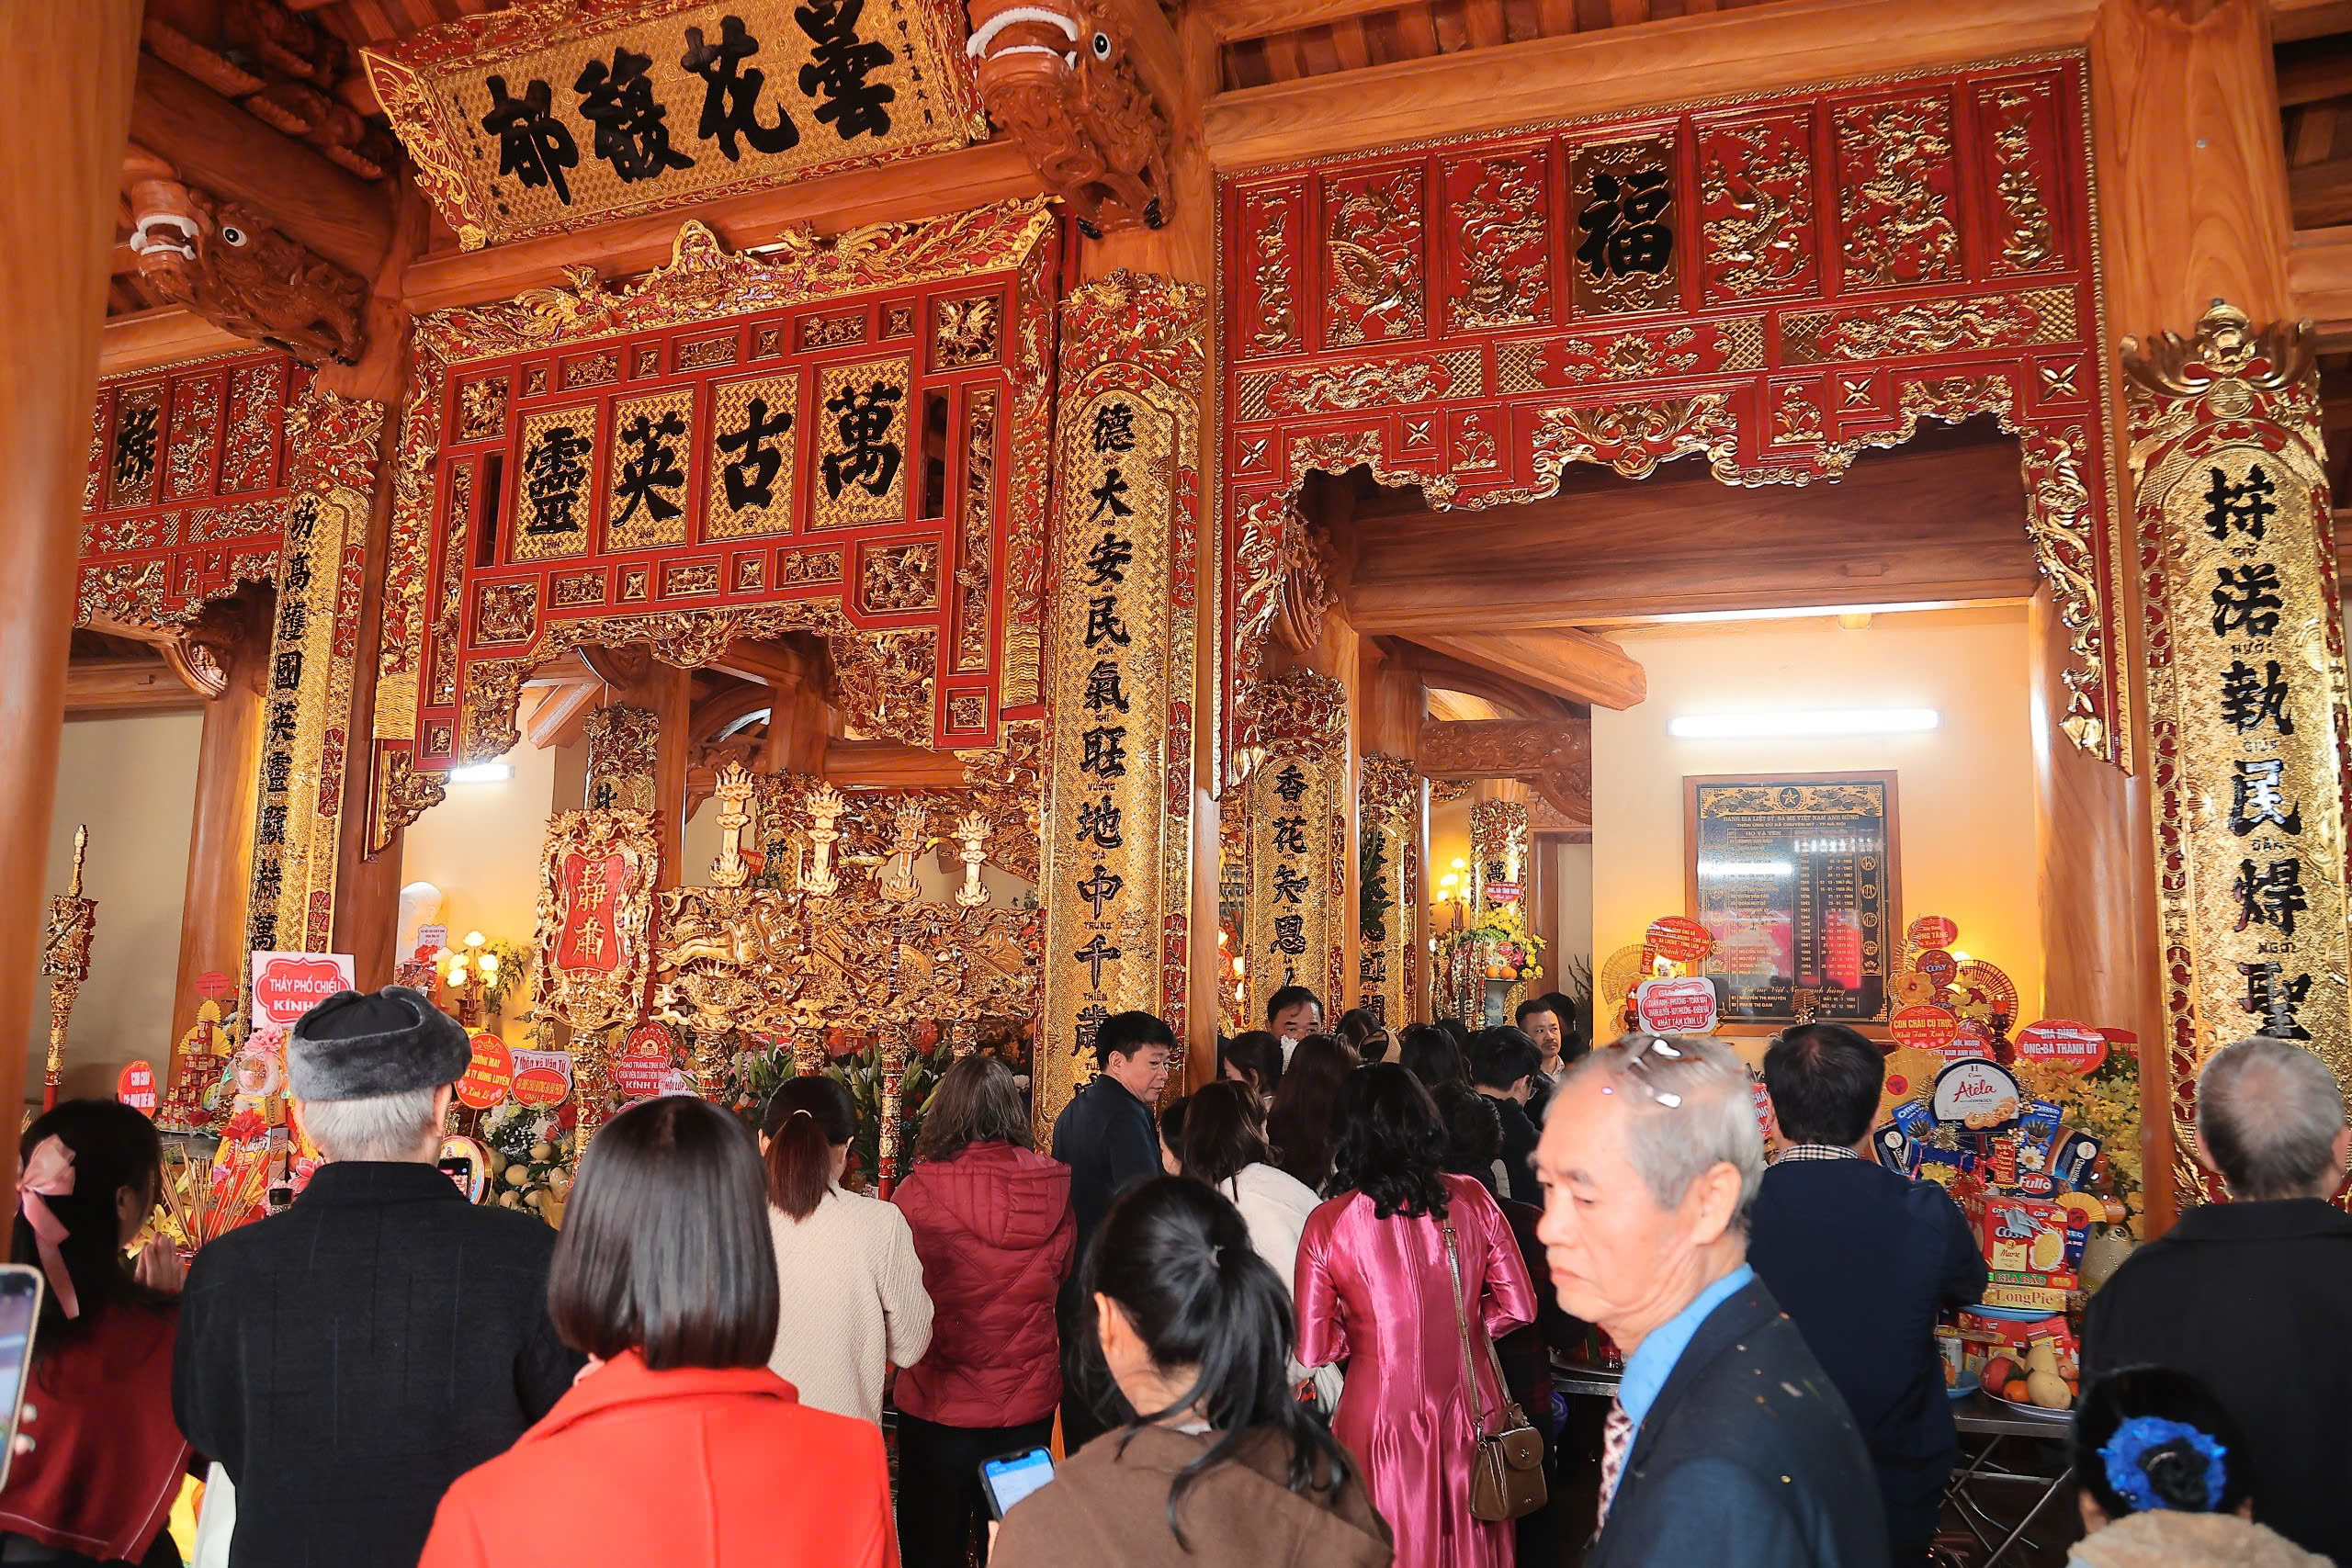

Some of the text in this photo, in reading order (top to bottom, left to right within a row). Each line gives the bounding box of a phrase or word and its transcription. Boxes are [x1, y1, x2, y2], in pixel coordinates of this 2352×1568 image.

[1577, 172, 1673, 280] 福
[1797, 812, 1812, 822] VIỆT
[1926, 964, 1947, 973] COSY
[314, 975, 341, 994] CHIẾU
[273, 998, 313, 1012] KÍNH
[1894, 1020, 1908, 1029] CON
[1908, 1018, 1926, 1028] CHÁU
[1927, 1019, 1937, 1031] CỤ
[2041, 1029, 2055, 1039] GIA
[2023, 1041, 2041, 1055] ÔNG
[2042, 1042, 2055, 1055] BÀ
[2056, 1042, 2085, 1055] THÀNH
[489, 1056, 502, 1068] MAY
[626, 1079, 650, 1089] KÍNH
[2018, 1175, 2052, 1190] Fullo
[1996, 1274, 2019, 1283] GIA
[1996, 1290, 2054, 1305] LongPie
